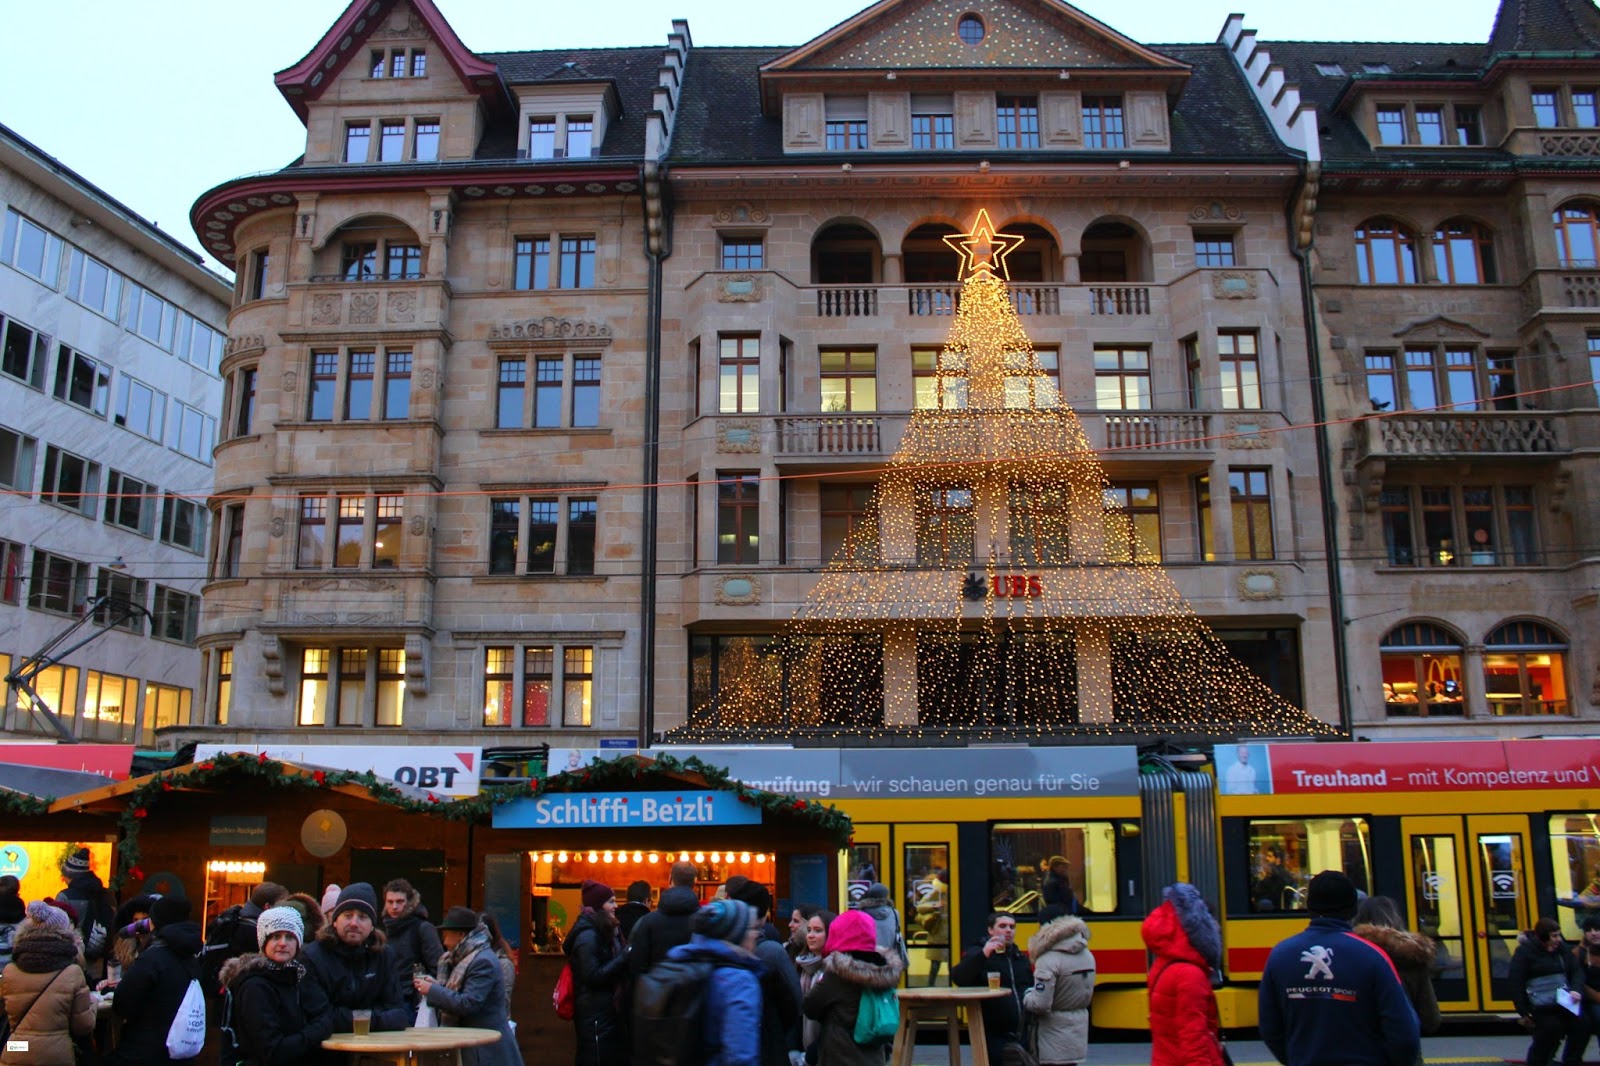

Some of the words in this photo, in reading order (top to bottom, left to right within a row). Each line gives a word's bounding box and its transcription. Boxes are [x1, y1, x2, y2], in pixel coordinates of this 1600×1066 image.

[992, 575, 1043, 598] UBS
[394, 766, 460, 788] OBT
[728, 775, 831, 796] prüfung
[853, 775, 883, 792] wir
[888, 776, 968, 792] schauen
[974, 778, 1032, 795] genau
[1038, 774, 1064, 791] für
[1070, 773, 1100, 791] Sie
[1292, 769, 1387, 787] Treuhand
[1408, 768, 1439, 785] mit
[1444, 768, 1549, 788] Kompetenz
[1554, 766, 1588, 783] und
[535, 795, 713, 825] Schliffi-Beizli
[1285, 986, 1332, 994] PEUGEOT
[1333, 987, 1357, 996] SPORT
